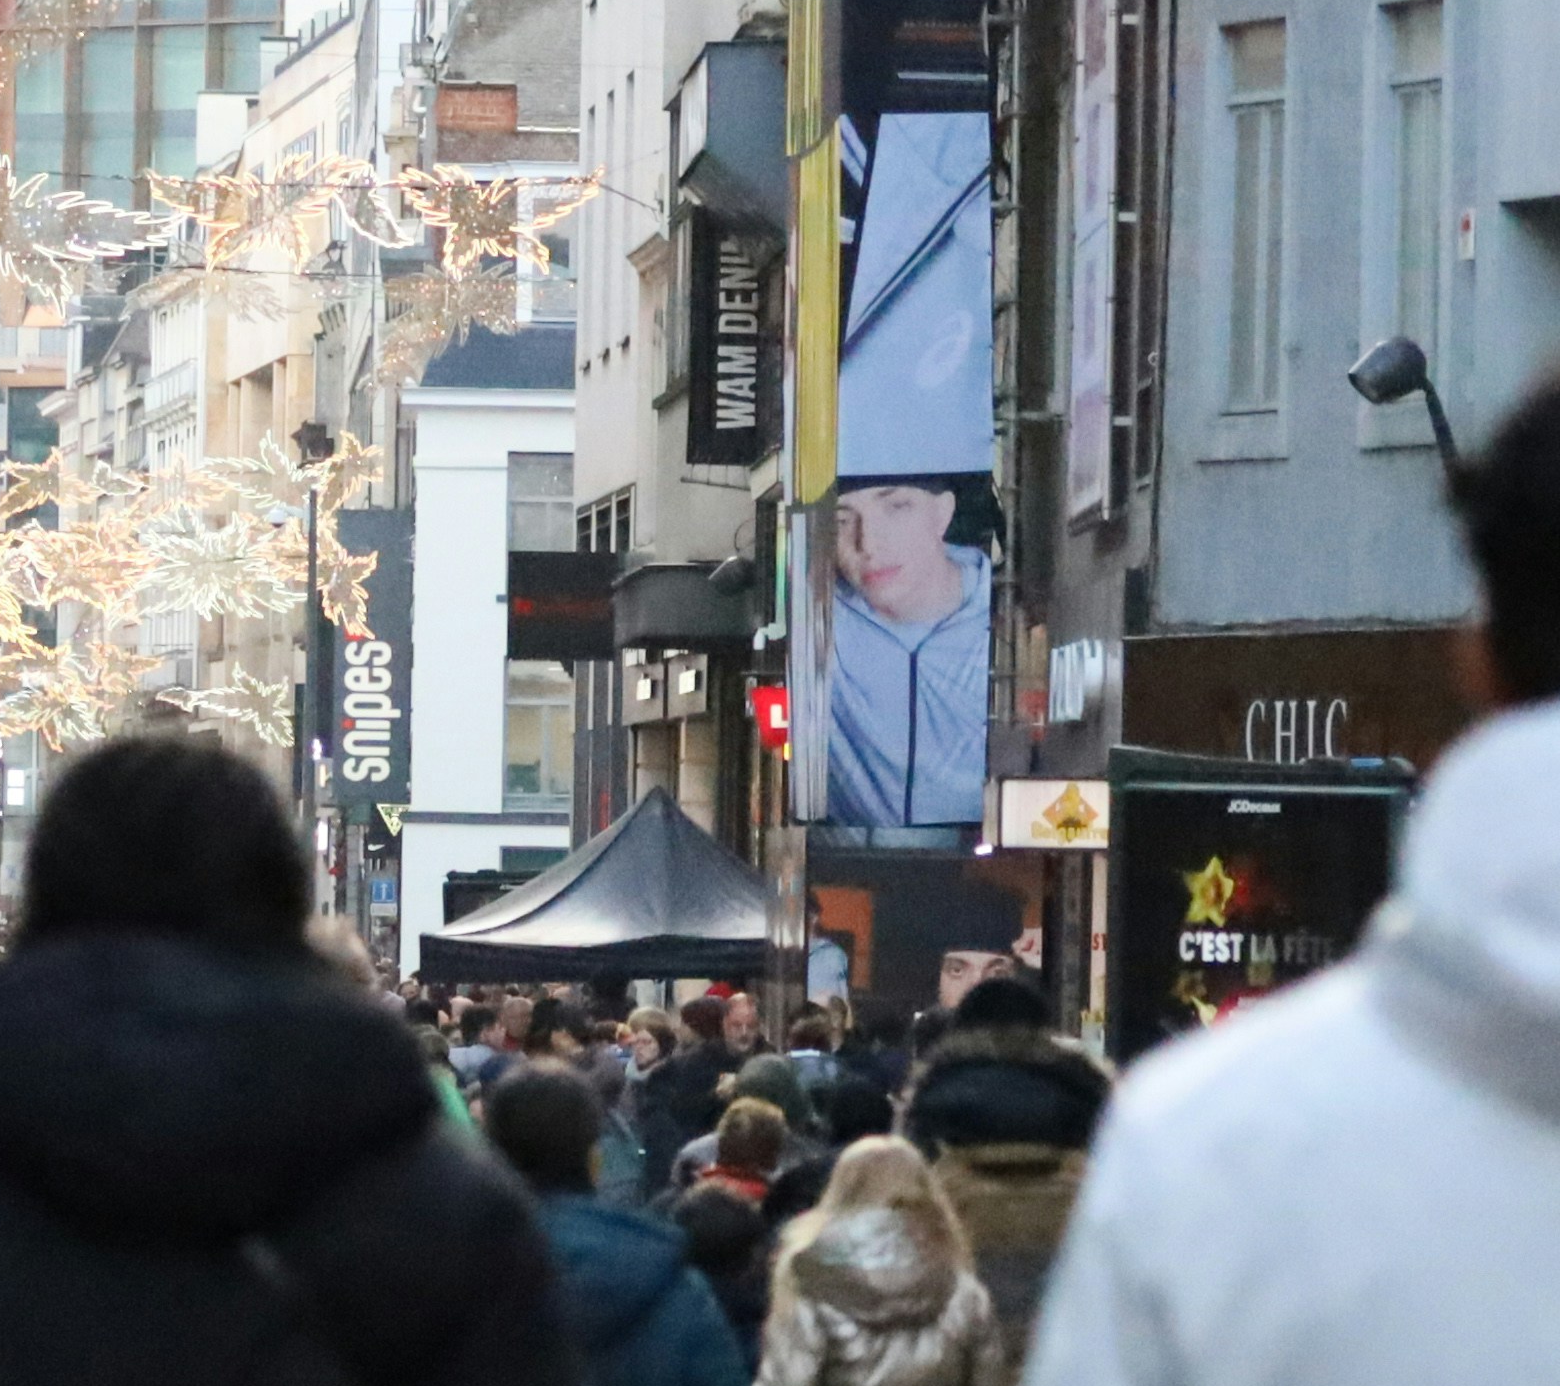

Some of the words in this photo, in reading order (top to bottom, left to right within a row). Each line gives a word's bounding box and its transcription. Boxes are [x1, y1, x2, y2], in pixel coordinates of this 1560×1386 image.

[715, 346, 758, 430] WAM
[342, 640, 402, 783] snipes
[1180, 930, 1243, 964] C'EST
[1250, 933, 1277, 964] LA
